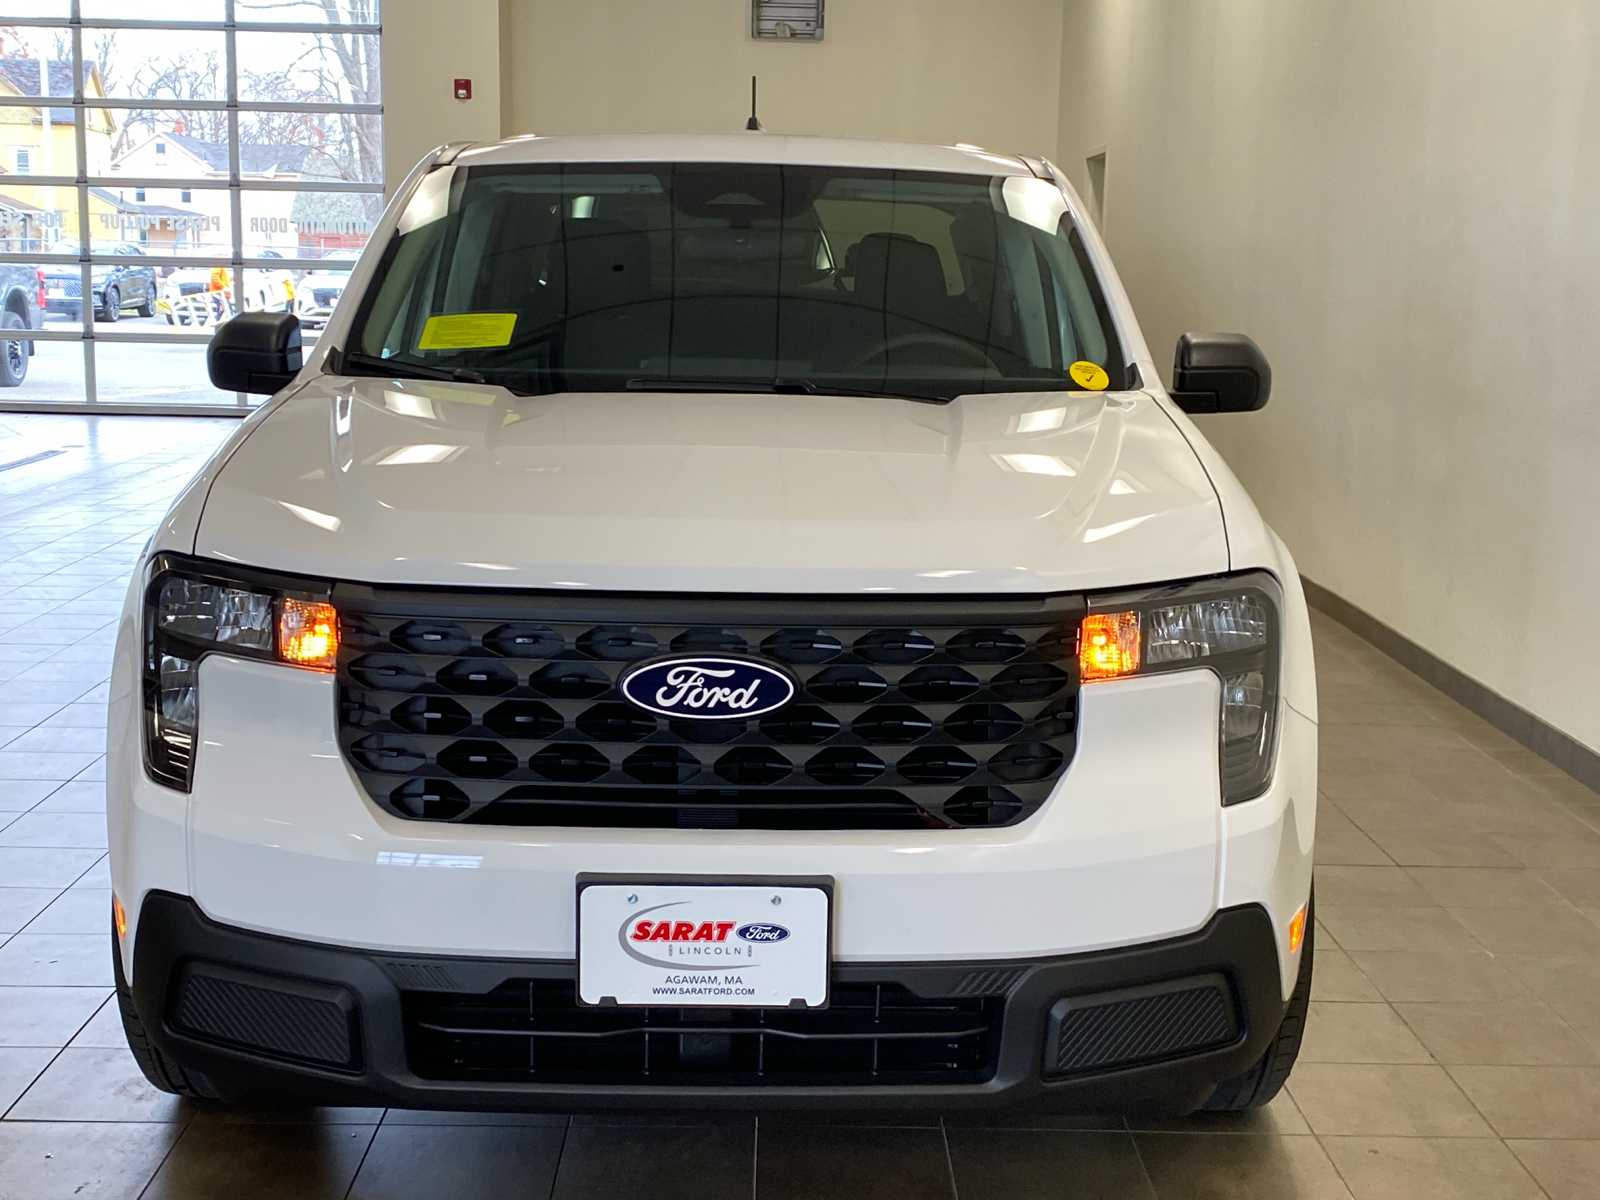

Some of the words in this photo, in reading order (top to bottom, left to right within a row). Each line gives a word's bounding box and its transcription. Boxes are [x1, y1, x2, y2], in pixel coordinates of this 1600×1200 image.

[655, 666, 761, 709] Ford
[630, 920, 736, 943] SARAT
[745, 925, 781, 941] Ford
[679, 946, 742, 956] LINCOLN
[664, 975, 722, 986] AGAWAM,
[724, 975, 743, 985] MA
[652, 987, 755, 996] WWW.SARATFORD.COM
